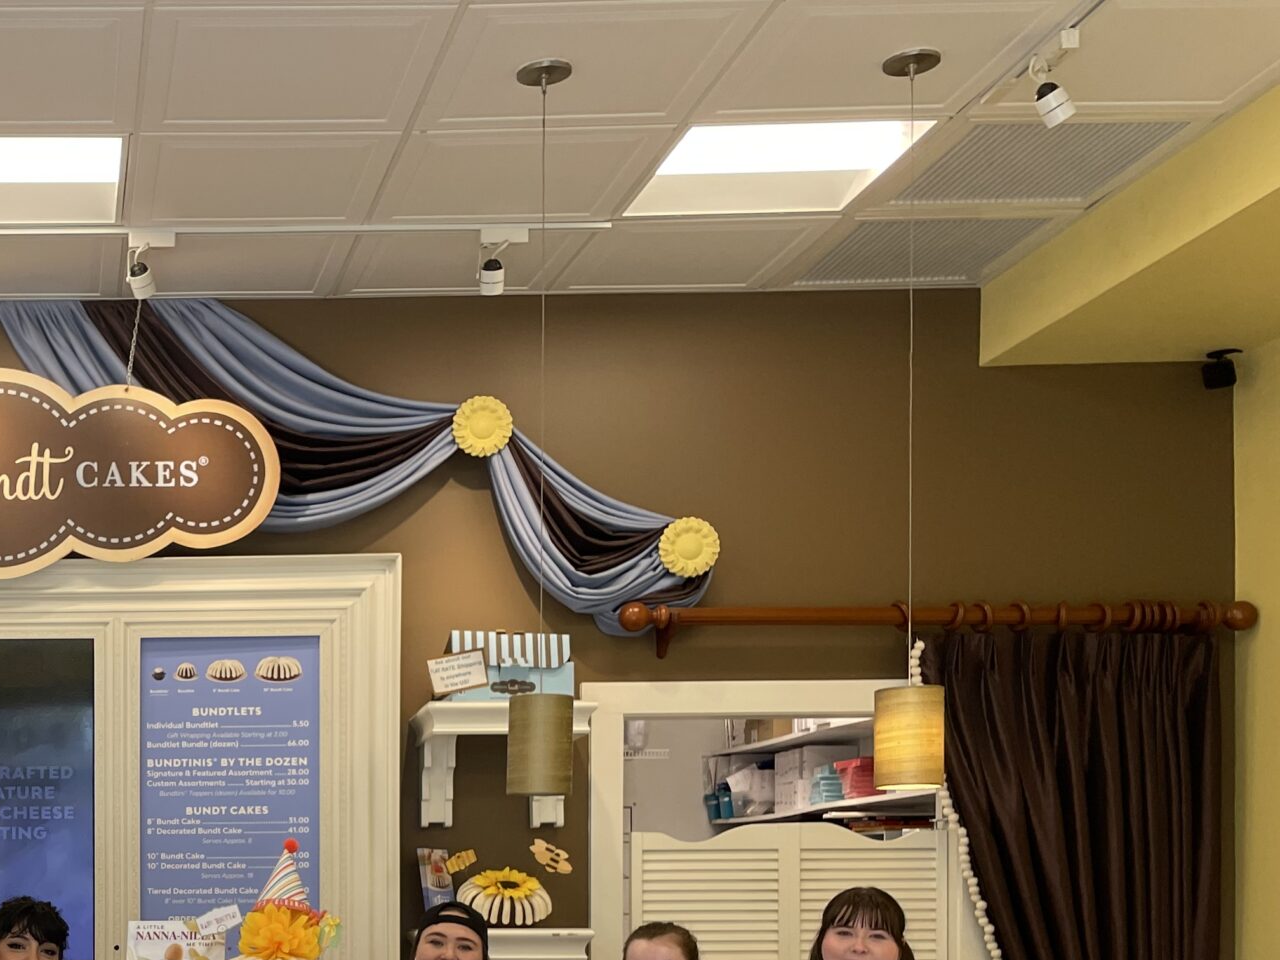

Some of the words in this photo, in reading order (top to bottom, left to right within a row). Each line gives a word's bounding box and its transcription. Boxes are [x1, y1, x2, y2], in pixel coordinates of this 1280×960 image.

[191, 706, 262, 717] BUNDTLETS
[146, 721, 185, 730] Individual
[185, 721, 219, 729] Bundtlet
[146, 741, 181, 749] Bundtlet
[181, 740, 208, 748] Bundle
[209, 740, 239, 749] (dozen)
[221, 757, 235, 767] BY
[238, 757, 263, 766] THE
[265, 756, 308, 766] DOZEN
[146, 769, 184, 778] Signature
[192, 769, 226, 777] Featured
[228, 768, 273, 777] Assortment
[146, 780, 178, 788] Custom
[178, 779, 226, 788] Assortments
[245, 778, 276, 788] Starting
[277, 779, 285, 787] at
[0, 806, 75, 820] CHEESE
[185, 806, 226, 816] BUNDT
[230, 805, 269, 815] CAKES
[156, 817, 180, 826] Bundt
[181, 817, 201, 826] Cake
[156, 827, 196, 835] Decorated
[197, 827, 221, 835] Bundt
[222, 827, 243, 835] Cake
[287, 826, 310, 834] 41.00
[160, 852, 184, 860] Bundt
[185, 852, 205, 860] Cake
[160, 862, 200, 870] Decorated
[201, 862, 225, 870] Bundt
[227, 861, 247, 869] Cake
[147, 887, 172, 896] Tiered
[172, 887, 213, 895] Decorated
[214, 887, 238, 895] Bundt
[239, 887, 259, 895] Cake
